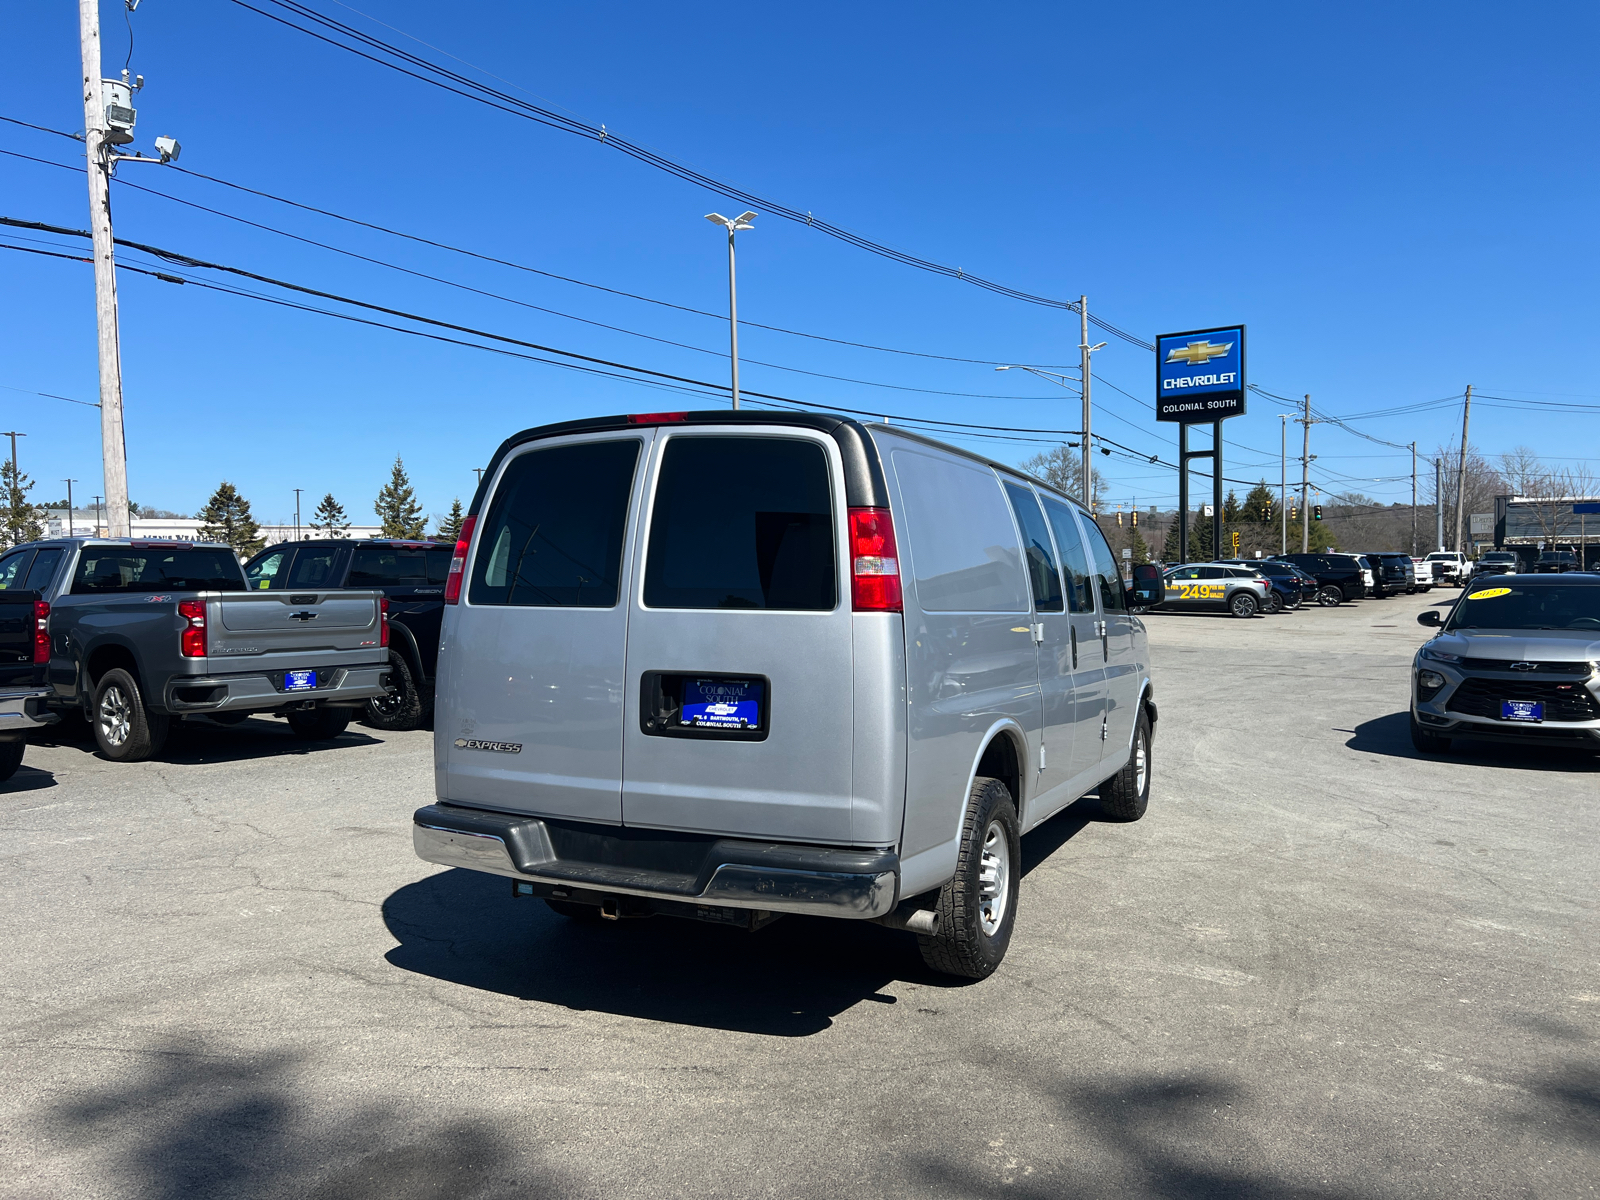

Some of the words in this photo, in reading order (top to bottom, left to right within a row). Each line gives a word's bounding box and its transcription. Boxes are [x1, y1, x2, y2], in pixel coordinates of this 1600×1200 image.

[1163, 372, 1236, 389] CHEVROLET
[1162, 402, 1205, 413] COLONIAL
[1207, 399, 1237, 409] SOUTH
[700, 685, 746, 696] COLONIAL
[705, 695, 739, 704] SOUTH
[696, 720, 722, 728] COLONIAL
[467, 740, 521, 752] EXPRESS
